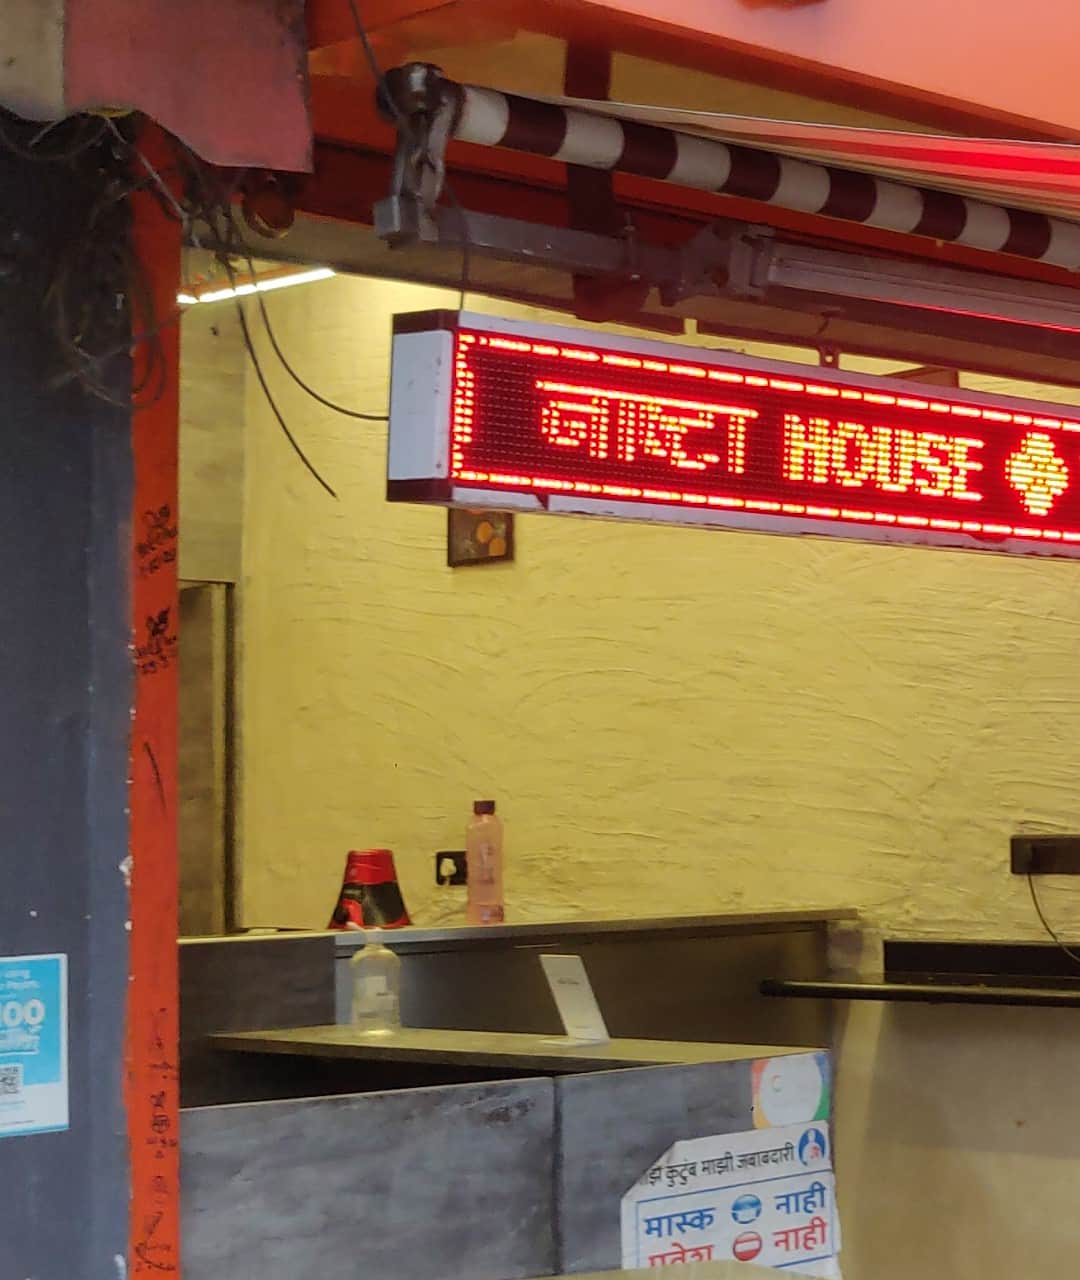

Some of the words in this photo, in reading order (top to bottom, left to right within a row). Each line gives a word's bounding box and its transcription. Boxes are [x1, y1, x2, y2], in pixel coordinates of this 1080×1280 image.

[783, 414, 985, 502] HOUSE
[644, 1207, 717, 1239] मास्क
[774, 1181, 827, 1215] नाही
[772, 1216, 828, 1252] नाही
